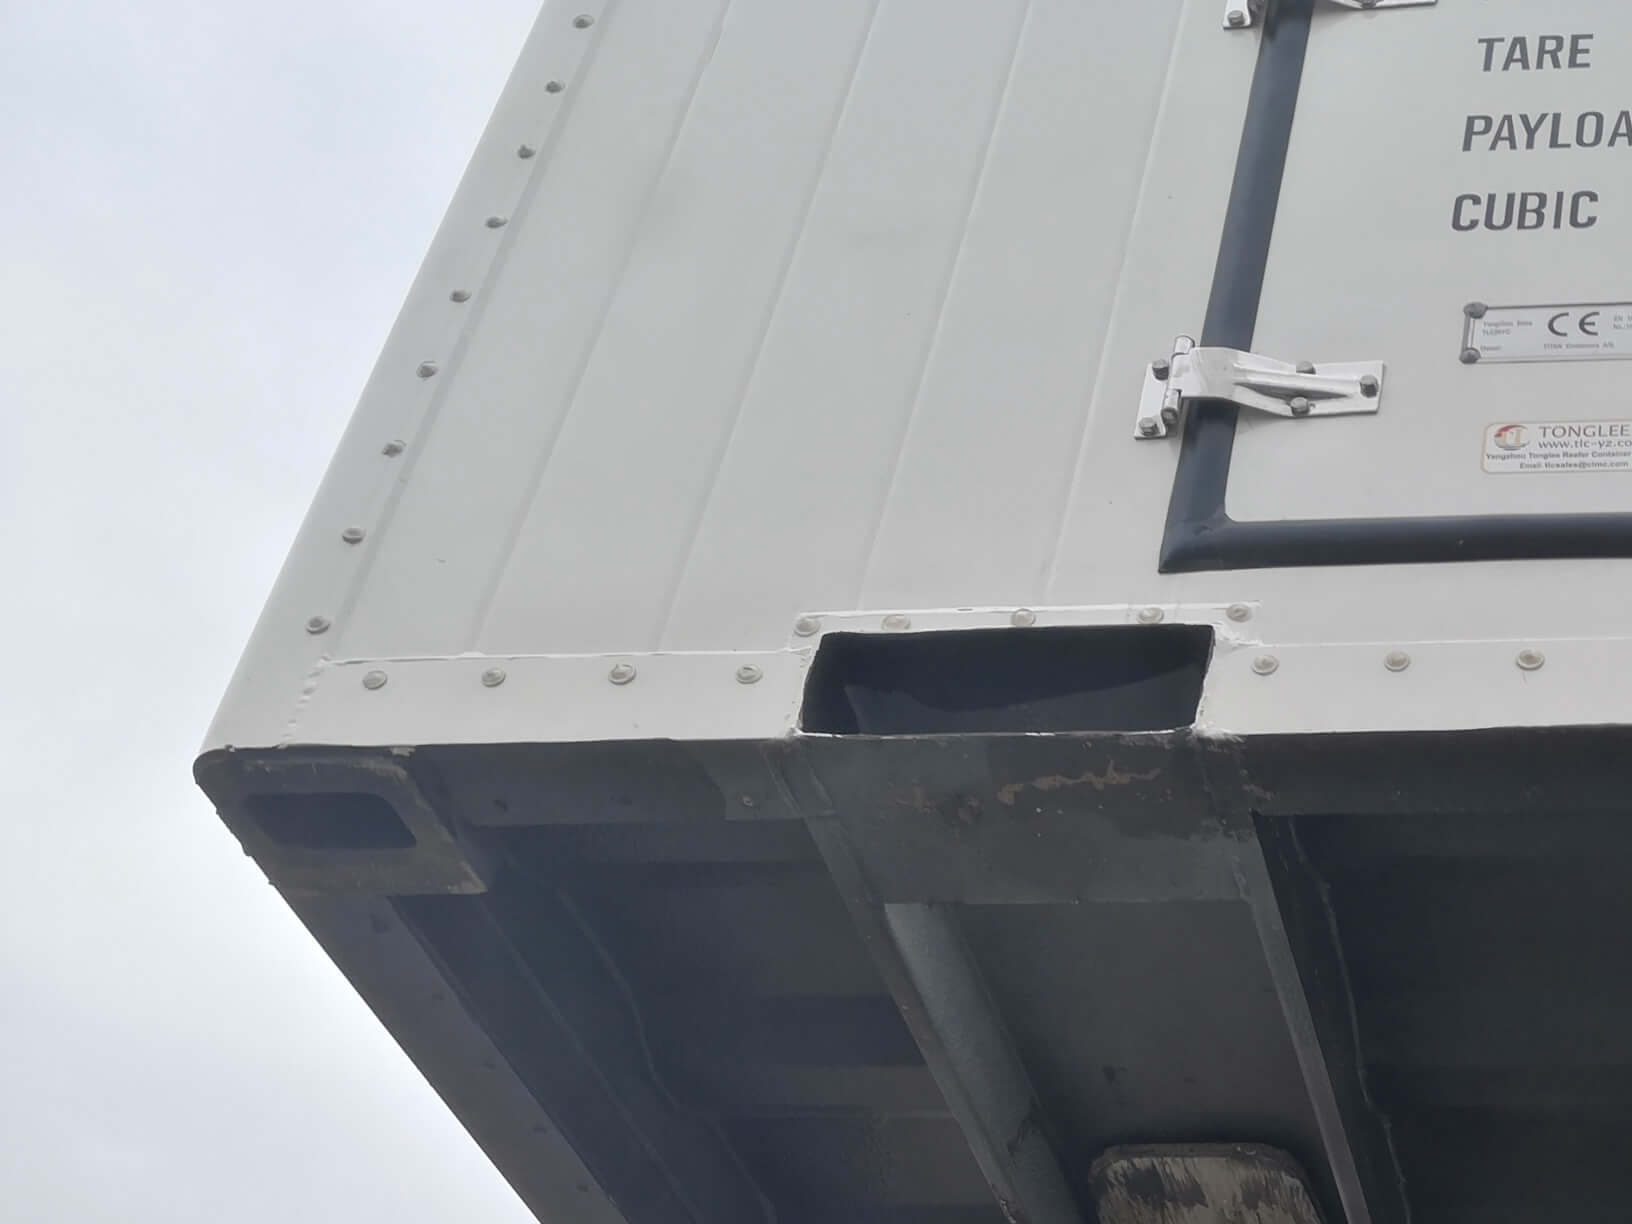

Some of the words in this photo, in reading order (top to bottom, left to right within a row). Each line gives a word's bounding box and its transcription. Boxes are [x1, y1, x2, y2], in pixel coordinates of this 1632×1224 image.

[1477, 33, 1594, 72] TARE
[1451, 190, 1599, 231] CUBIC
[1538, 424, 1631, 438] TONGLEE
